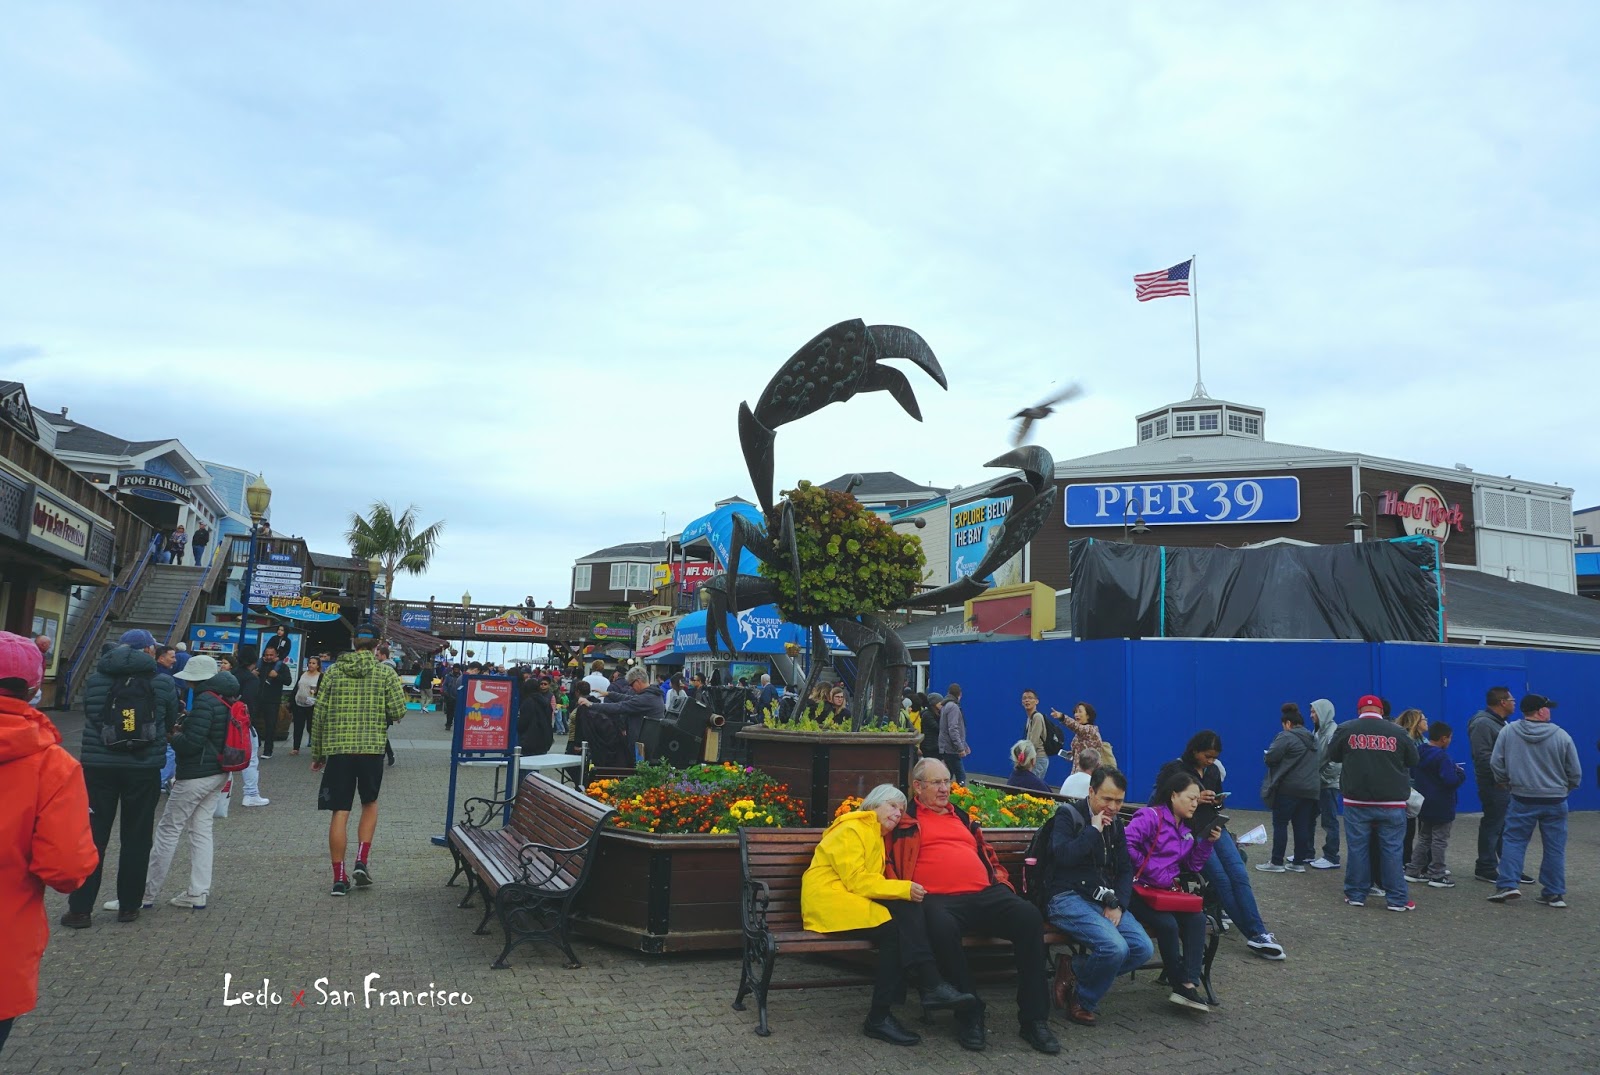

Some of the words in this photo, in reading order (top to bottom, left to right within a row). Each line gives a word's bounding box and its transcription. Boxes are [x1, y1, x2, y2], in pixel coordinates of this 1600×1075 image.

[123, 476, 146, 486] FOG
[148, 477, 192, 499] HARBOR
[1095, 484, 1199, 517] PIER
[1205, 481, 1264, 521] 39
[954, 506, 986, 529] EXPLORE
[988, 497, 1014, 520] BELOW
[1383, 490, 1425, 520] Hard
[1426, 497, 1464, 532] Rock
[954, 530, 968, 547] THE
[968, 526, 983, 545] BAY
[686, 567, 700, 576] NFL
[702, 566, 723, 576] Shp
[748, 615, 783, 625] AQUARIUM
[675, 631, 698, 650] AQUARIUM
[756, 626, 782, 639] BAY
[745, 653, 769, 664] MAPS
[1348, 734, 1397, 752] 49ERS
